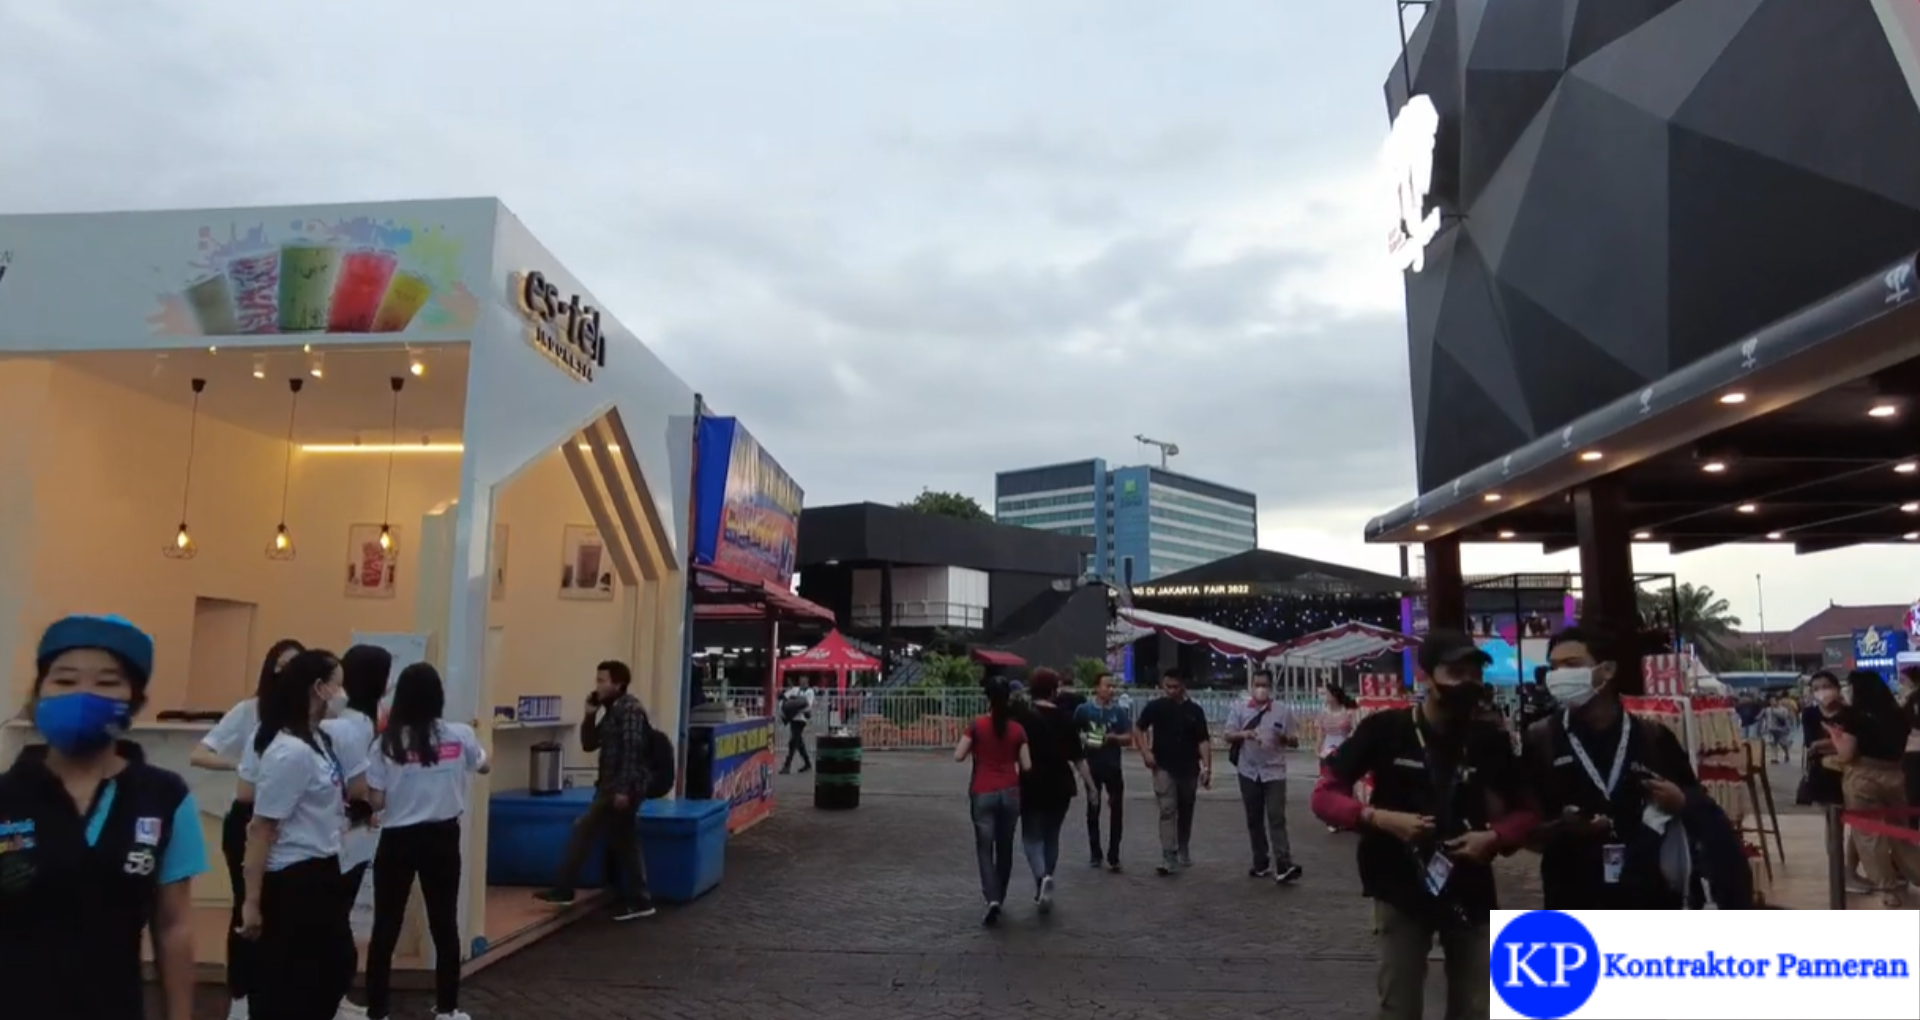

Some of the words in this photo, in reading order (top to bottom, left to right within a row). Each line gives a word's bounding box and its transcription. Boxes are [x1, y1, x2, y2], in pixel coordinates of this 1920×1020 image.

[1157, 585, 1200, 596] JAKARTA
[1203, 583, 1226, 595] FAIR
[1227, 583, 1249, 595] 2022
